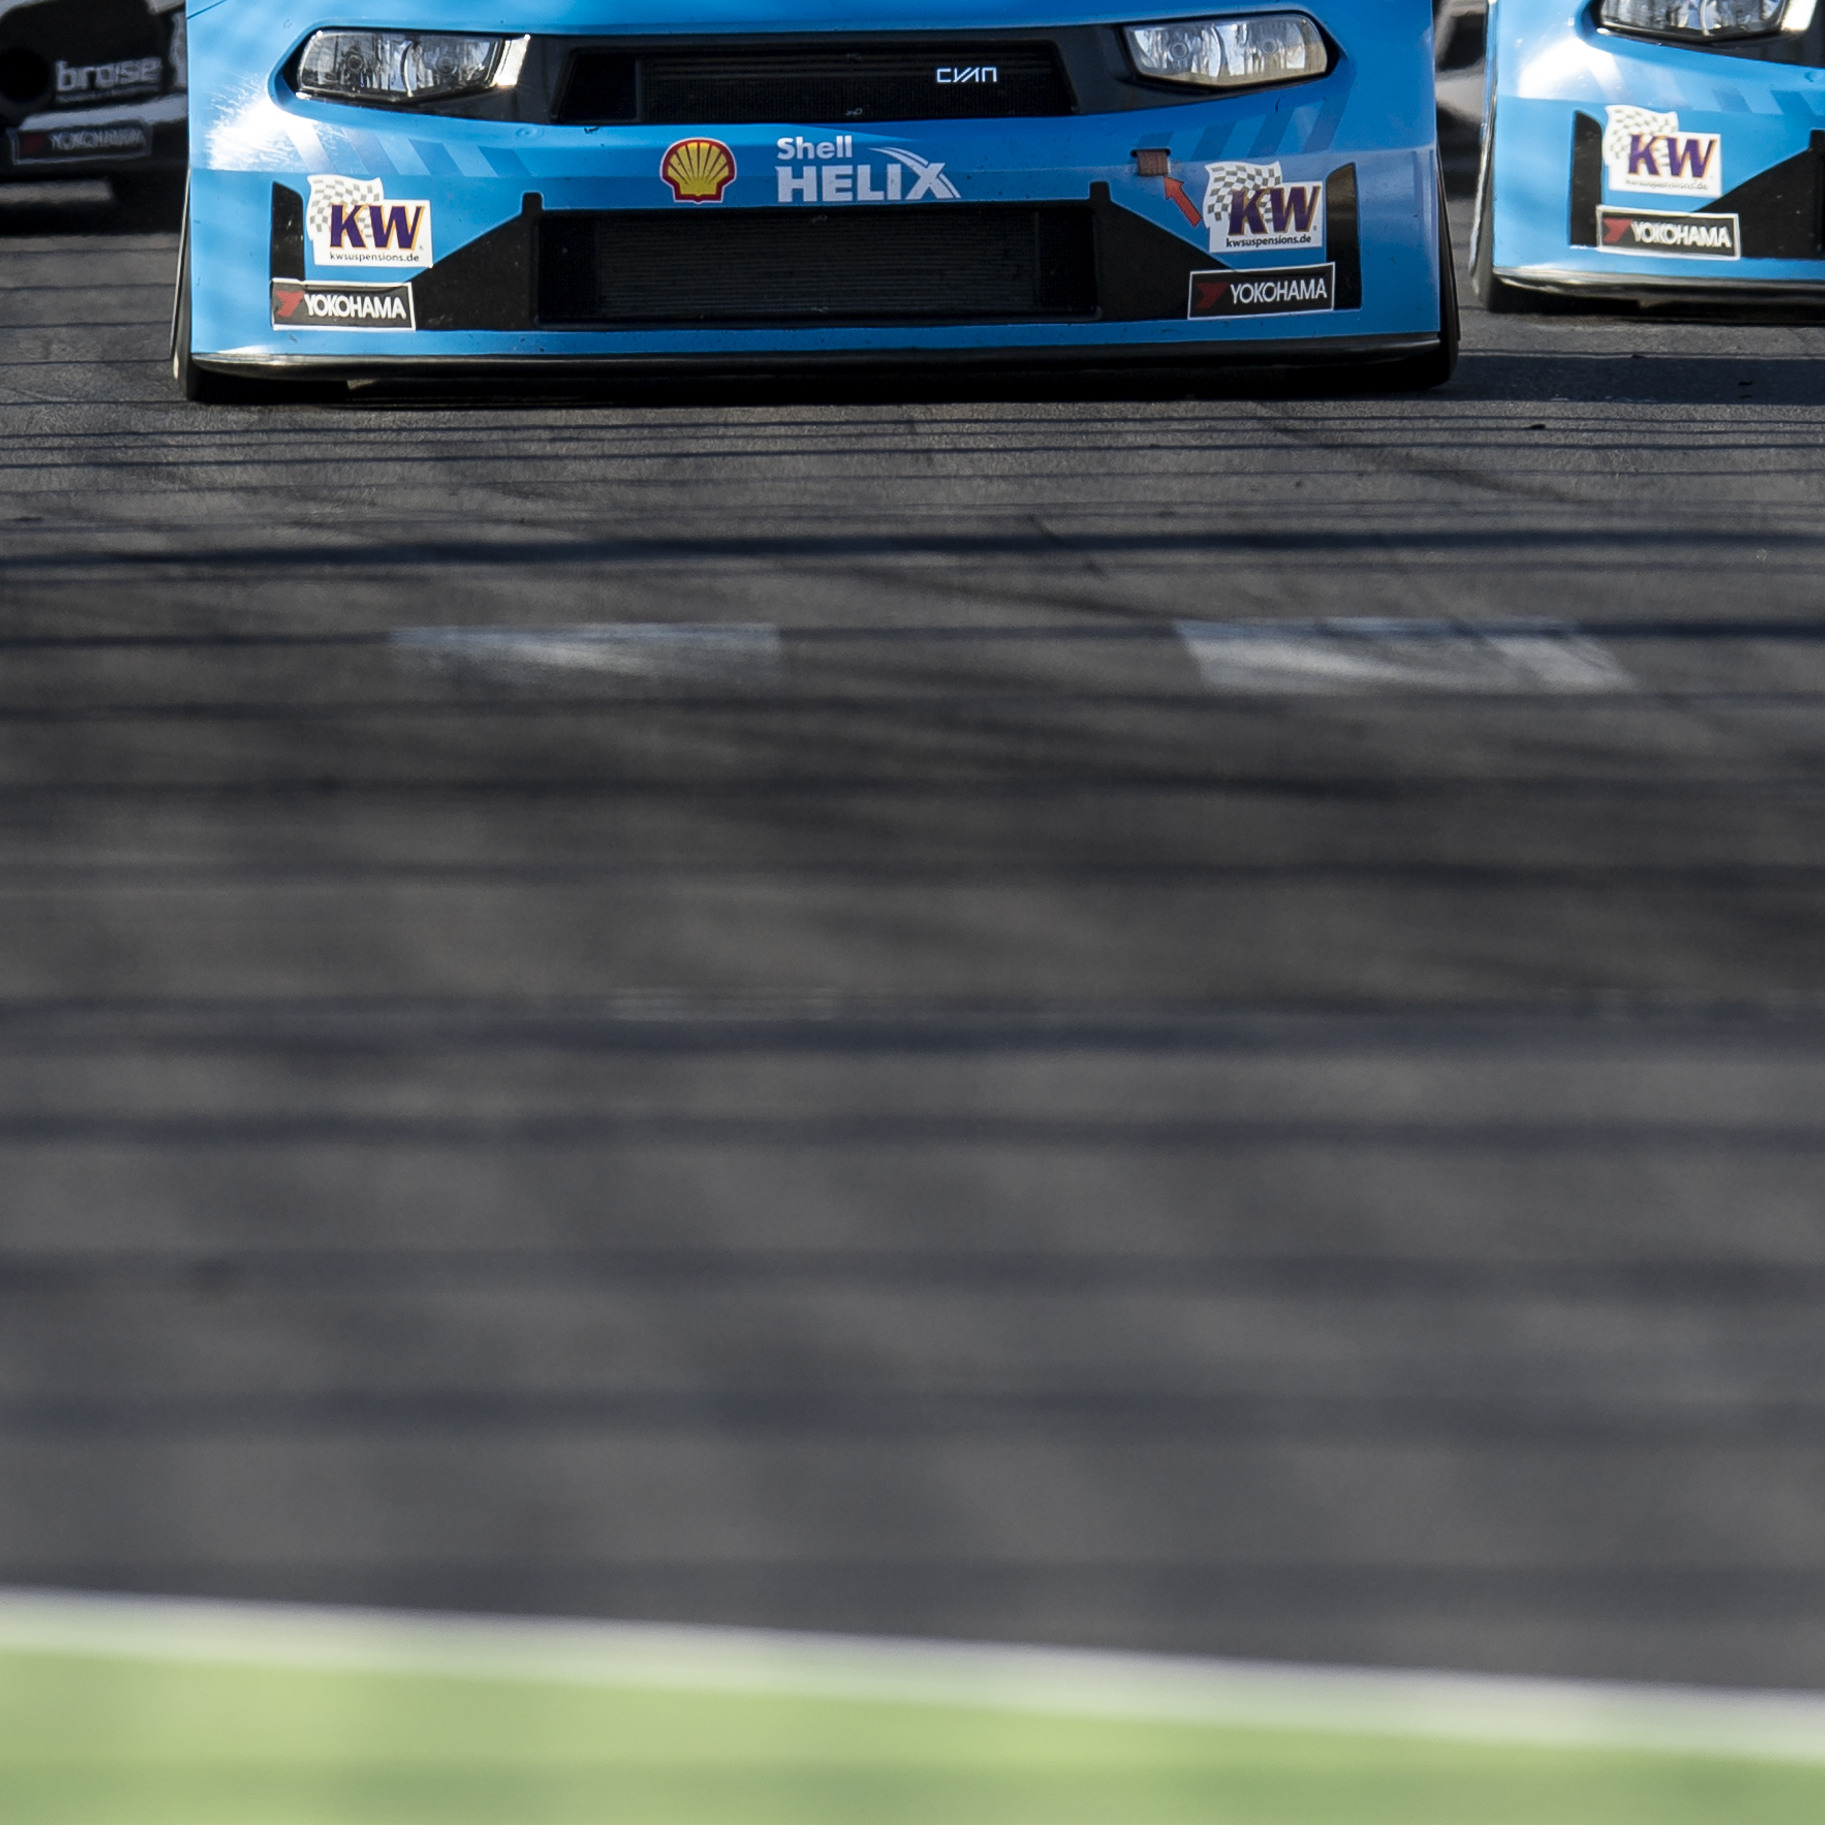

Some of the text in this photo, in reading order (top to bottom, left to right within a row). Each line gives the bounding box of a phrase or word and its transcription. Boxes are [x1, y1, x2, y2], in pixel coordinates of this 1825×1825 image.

[55, 56, 163, 93] brose
[48, 128, 148, 151] YOKOHAMA
[776, 135, 853, 160] Shell
[1627, 133, 1718, 179] KW
[775, 161, 962, 203] HELIX
[1227, 185, 1322, 236] KW
[329, 203, 426, 250] KW
[1630, 220, 1732, 249] YOKOHAMA
[1226, 234, 1312, 249] kwsuspensions.de
[329, 252, 420, 263] kwsuspensions.de
[1230, 278, 1328, 305] YOKOHAMA
[304, 293, 407, 320] YOKOHAMA
